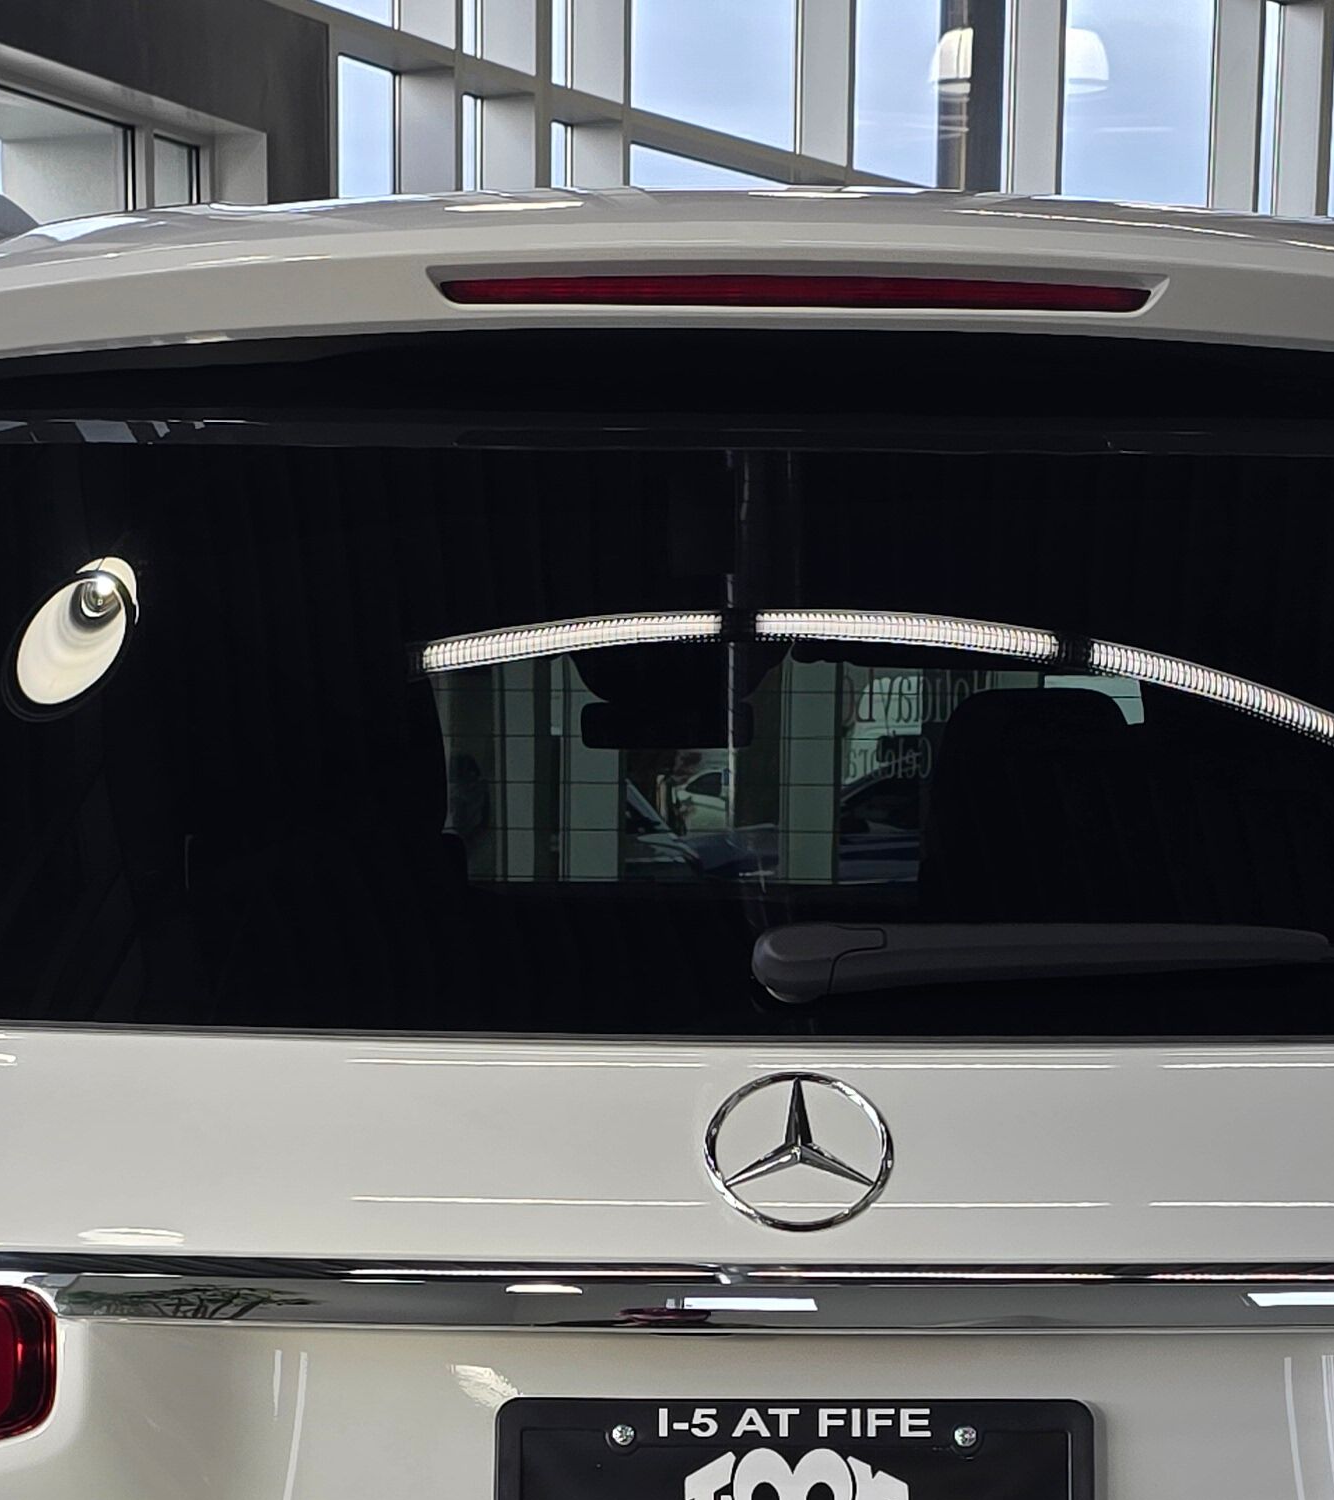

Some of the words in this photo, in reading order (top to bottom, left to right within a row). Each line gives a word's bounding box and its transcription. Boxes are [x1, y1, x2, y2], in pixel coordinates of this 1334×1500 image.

[657, 1408, 719, 1438] I-5
[732, 1408, 800, 1437] AT
[818, 1408, 933, 1437] FIFE
